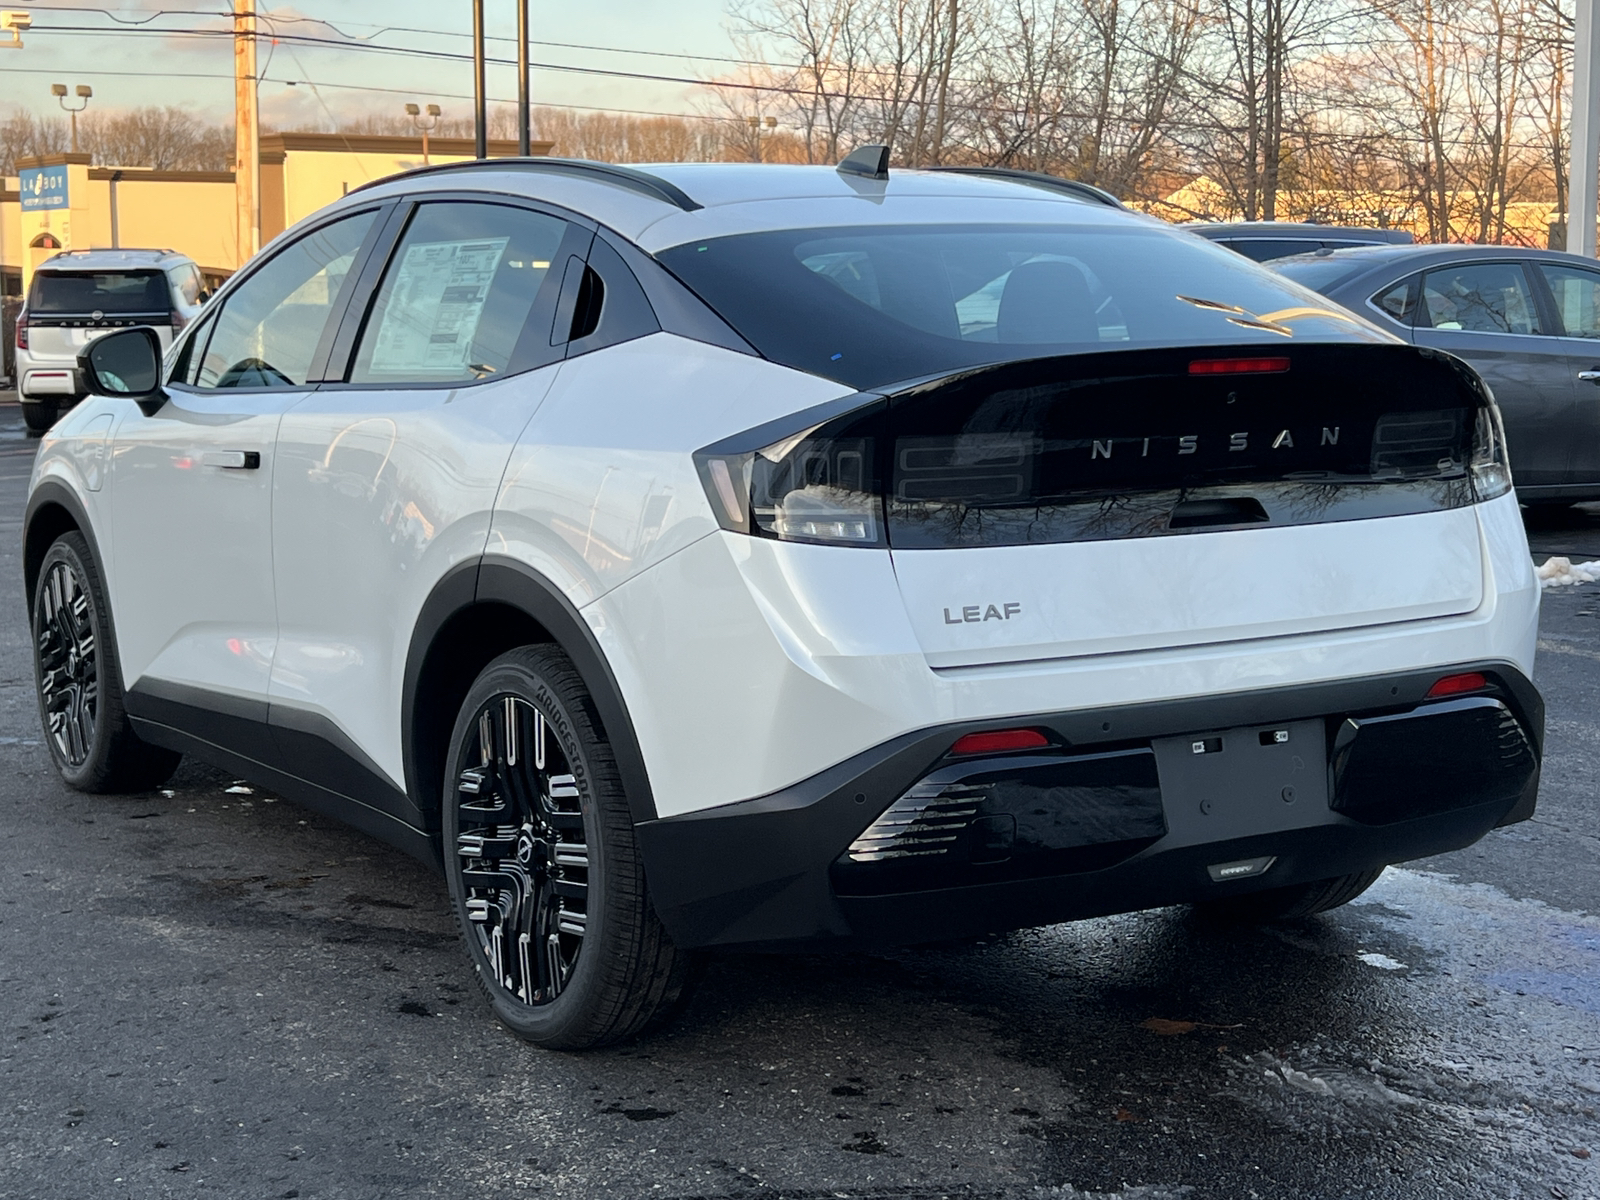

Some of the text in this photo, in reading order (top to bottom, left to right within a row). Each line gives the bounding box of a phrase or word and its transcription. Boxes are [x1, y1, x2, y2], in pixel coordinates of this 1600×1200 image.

[1091, 427, 1340, 460] NISSAN
[943, 602, 1021, 624] LEAF
[536, 684, 592, 805] BRIDGESTONE
